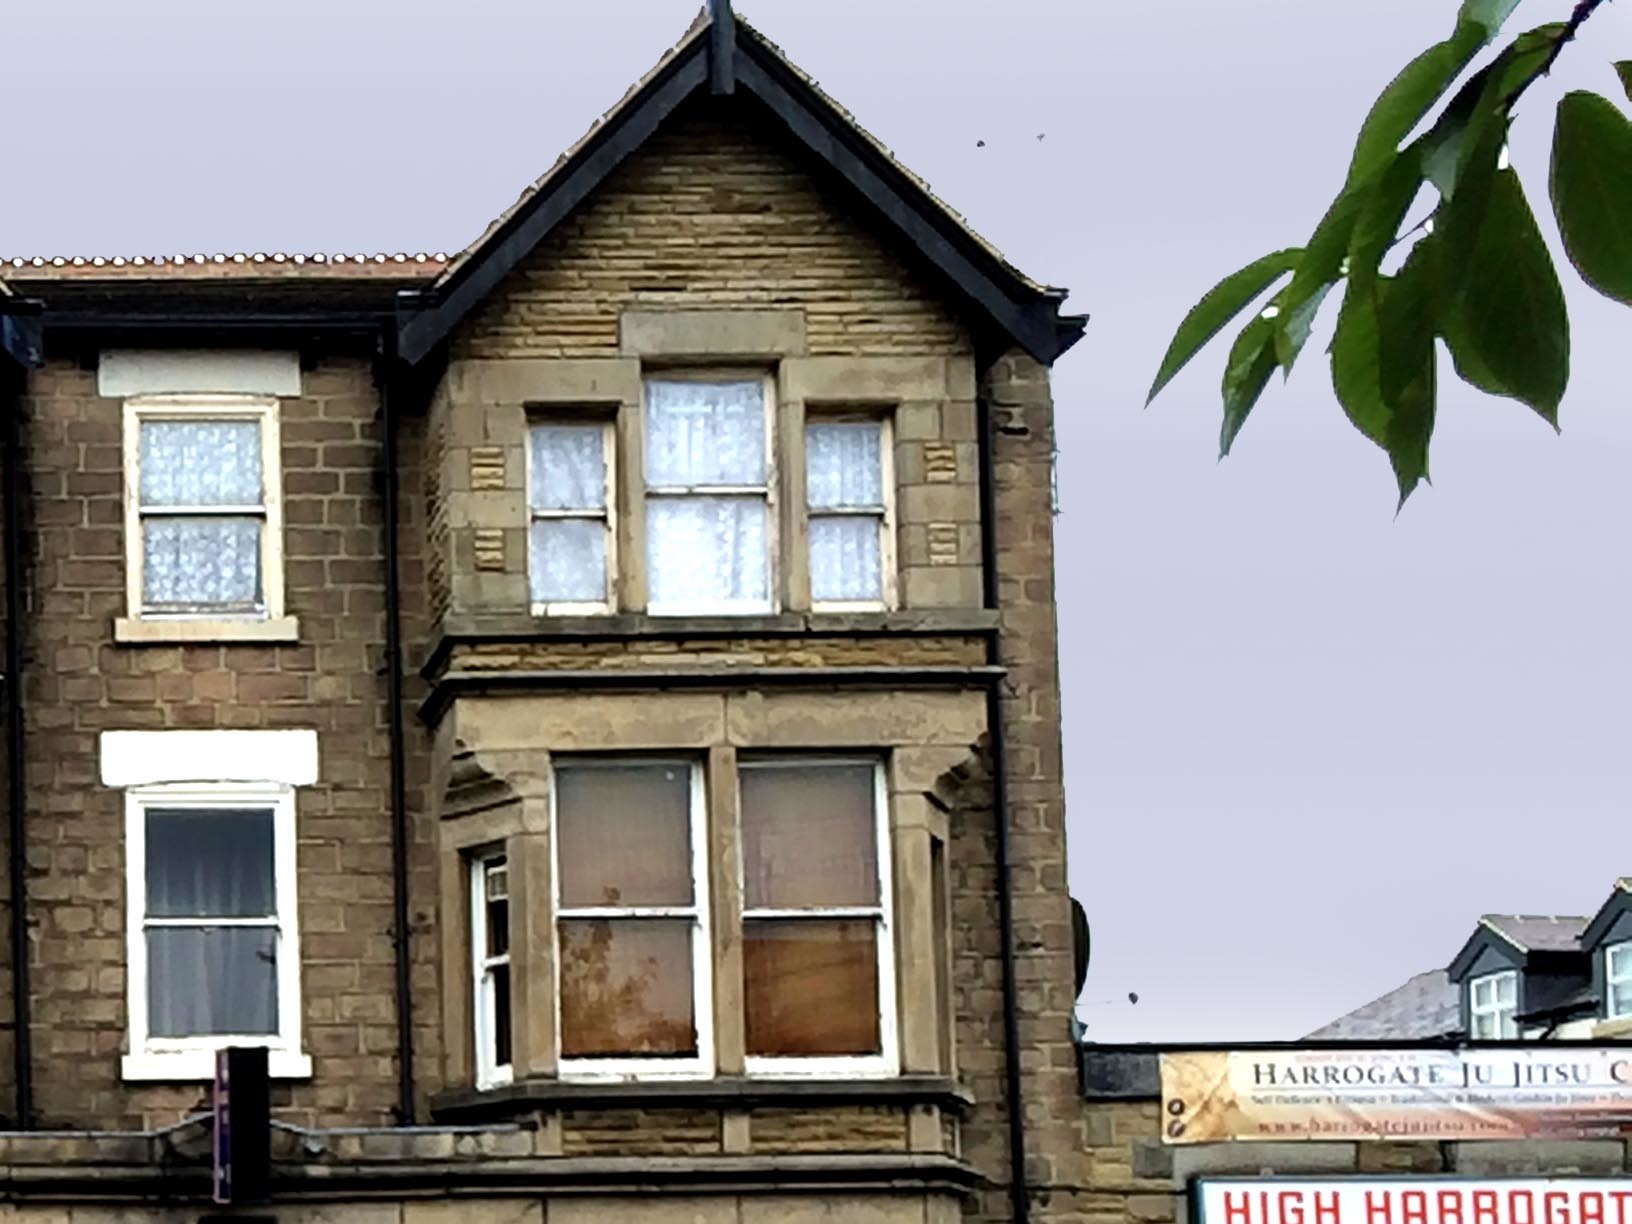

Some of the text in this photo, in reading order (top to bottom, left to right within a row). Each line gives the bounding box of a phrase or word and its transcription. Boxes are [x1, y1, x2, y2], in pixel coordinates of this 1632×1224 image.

[1253, 1062, 1444, 1085] HARROGATE
[1462, 1062, 1492, 1088] JU
[1513, 1062, 1591, 1088] JITSU
